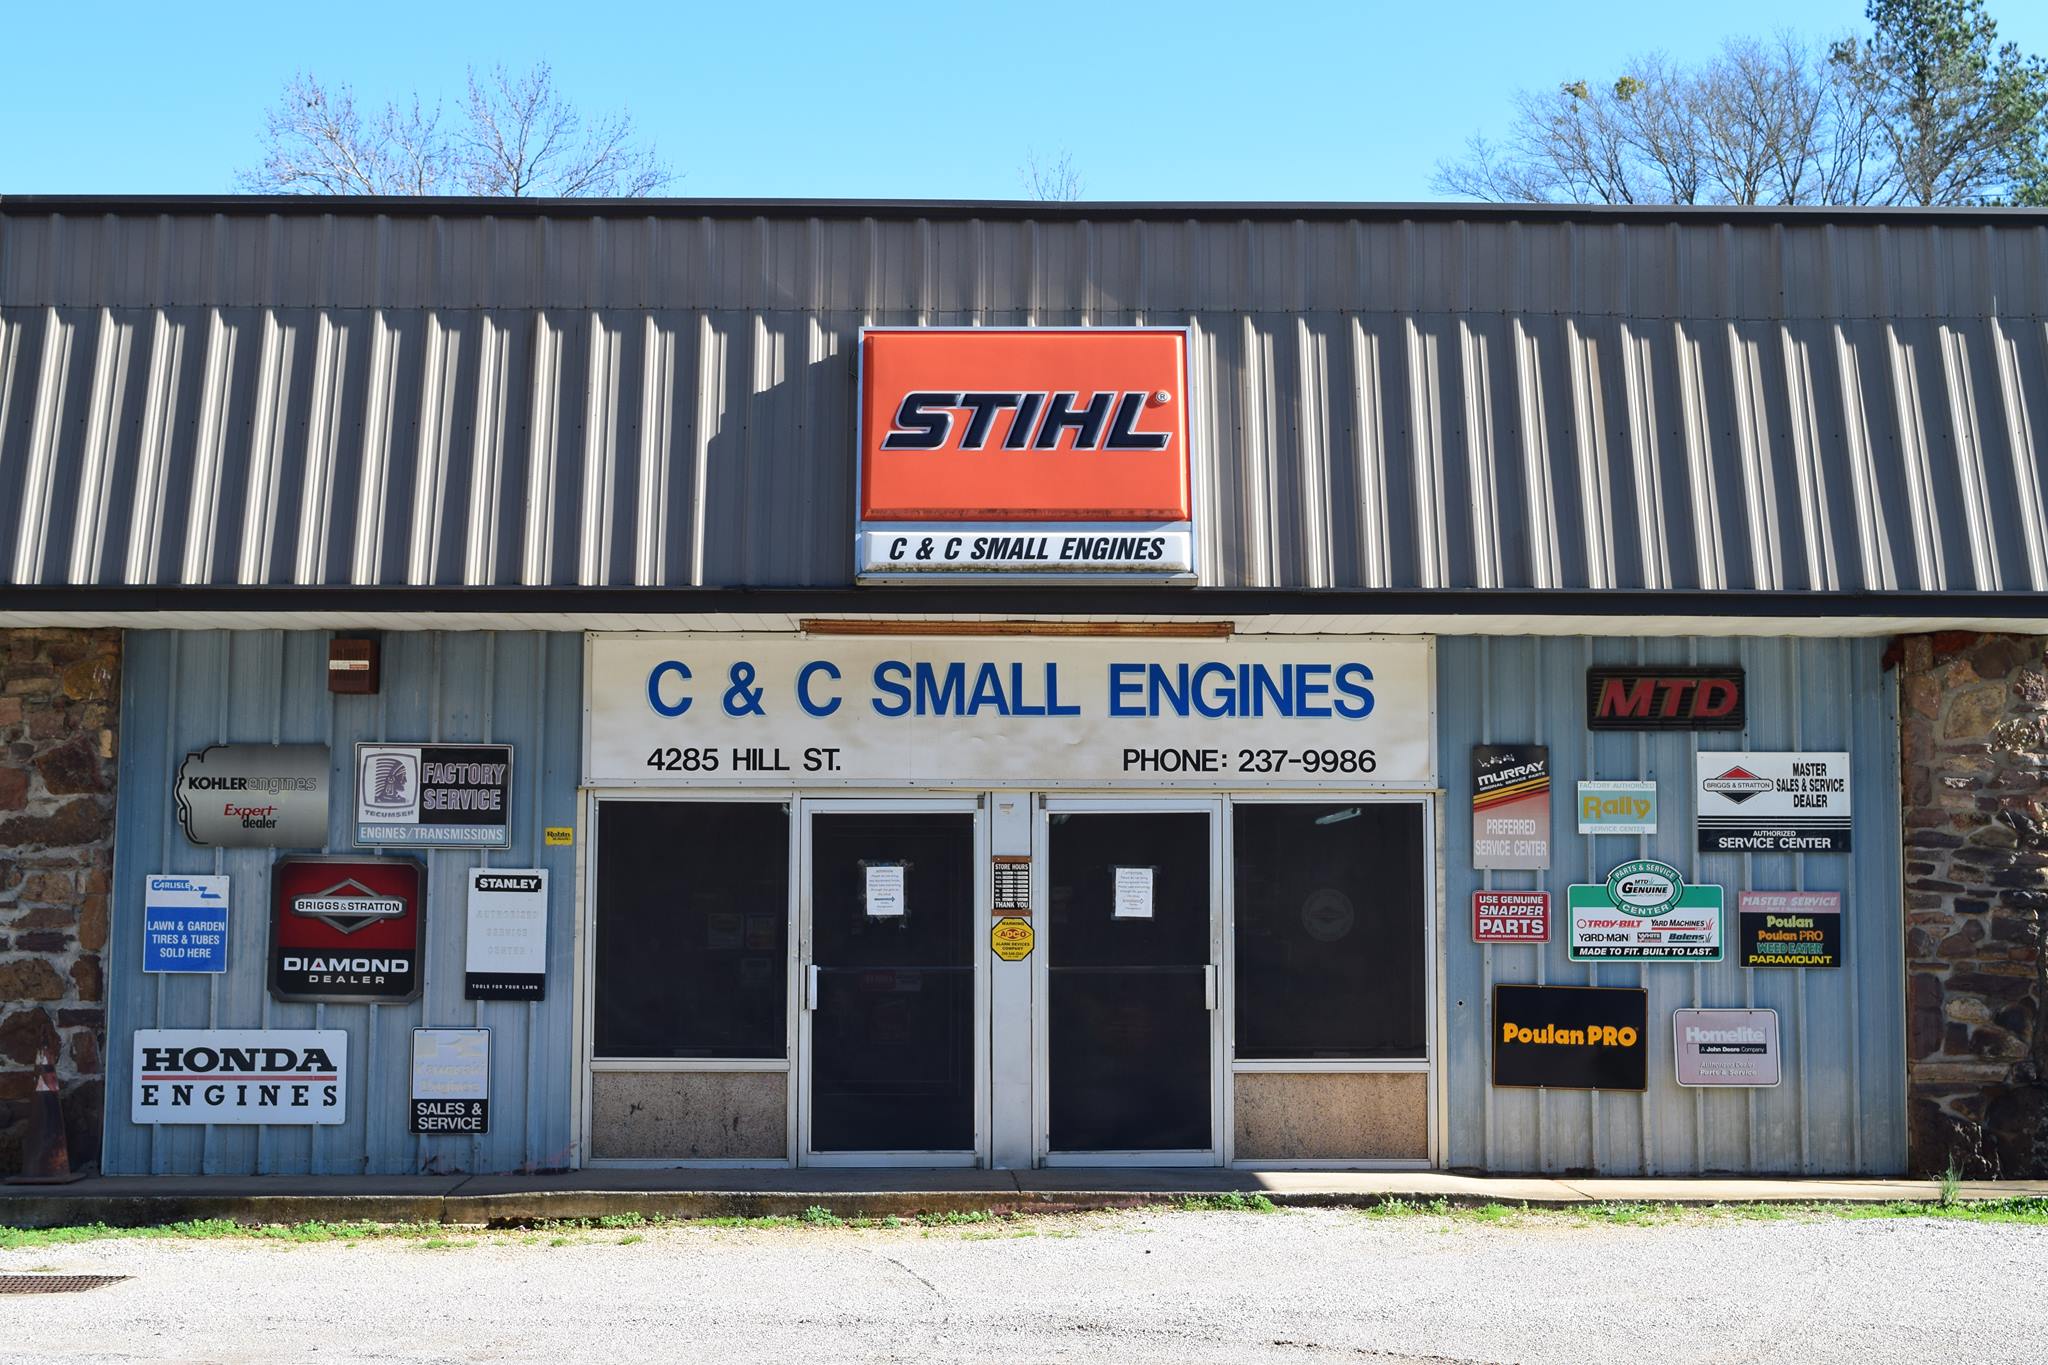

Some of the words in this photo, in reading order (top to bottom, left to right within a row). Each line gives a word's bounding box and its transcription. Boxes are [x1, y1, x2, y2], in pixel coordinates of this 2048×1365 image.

[880, 391, 1173, 450] STIHL
[890, 537, 907, 561] C
[916, 537, 935, 560] &
[944, 537, 962, 561] C
[970, 537, 1049, 560] SMALL
[1060, 537, 1165, 560] ENGINES
[646, 660, 693, 719] C
[721, 661, 766, 718] &
[796, 660, 842, 719] C
[870, 660, 1081, 719] SMALL
[1108, 662, 1375, 720] ENGINES
[1597, 677, 1738, 718] MTD
[647, 747, 719, 771] 4285
[732, 748, 790, 771] HILL
[803, 747, 841, 771] ST.
[1123, 749, 1228, 772] PHONE:
[1238, 749, 1377, 773] 237-9986
[423, 762, 506, 785] FACTORY
[1478, 760, 1544, 786] MURRAY
[1792, 763, 1827, 776] MASTER
[1776, 778, 1799, 792] SALES
[1801, 779, 1807, 792] &
[1809, 778, 1845, 792] SERVICE
[423, 789, 501, 811] SERVICE
[1793, 794, 1828, 808] DEALER
[224, 803, 278, 820] Expert
[365, 810, 414, 818] TECUMSEH
[1583, 796, 1650, 819] Rally
[242, 815, 277, 829] dealer
[1486, 819, 1536, 835] PREFERRED
[1475, 840, 1511, 856] SERVICE
[1514, 841, 1547, 857] CENTER
[1718, 838, 1774, 849] SERVICE
[1779, 838, 1831, 849] CENTER
[1615, 864, 1637, 878] PARTS
[1646, 864, 1676, 878] SERVICE
[153, 880, 191, 891] CARLISLE
[479, 878, 538, 889] STANLEY
[1622, 882, 1668, 894] GENUINE
[297, 901, 340, 911] BRIGGS
[340, 903, 347, 911] &
[347, 902, 400, 912] STRATTON
[1479, 895, 1498, 903] USE
[1500, 896, 1543, 904] GENUINE
[1742, 896, 1786, 906] MASTER
[1791, 896, 1837, 906] SERVICE
[1479, 905, 1544, 916] SNAPPER
[1622, 904, 1669, 915] CENTER
[147, 921, 175, 931] LAWN
[177, 921, 184, 931] &
[187, 921, 225, 932] GARDEN
[1479, 919, 1544, 934] PARTS
[1587, 920, 1642, 929] TROY-BILT
[1651, 919, 1668, 927] YARD
[1669, 919, 1705, 927] MACHINES
[1766, 915, 1814, 928] Poulan
[152, 934, 179, 944] TIRES
[181, 934, 188, 945] &
[190, 934, 220, 945] TUBES
[1758, 930, 1797, 941] Poulan
[1799, 930, 1824, 941] PRO
[160, 947, 185, 958] SOLD
[187, 948, 212, 958] HERE
[1757, 942, 1787, 954] WEED
[1788, 942, 1824, 954] EATER
[284, 957, 409, 973] DIAMOND
[1749, 955, 1832, 964] PARAMOUNT
[309, 975, 385, 984] DEALER
[1503, 1022, 1584, 1045] Poulan
[1587, 1025, 1637, 1047] PRO
[1685, 1026, 1764, 1042] Homelite
[142, 1047, 337, 1072] HONDA
[141, 1085, 337, 1106] ENGINES
[417, 1102, 465, 1116] SALES
[471, 1102, 482, 1115] &
[418, 1117, 482, 1130] SERVICE
